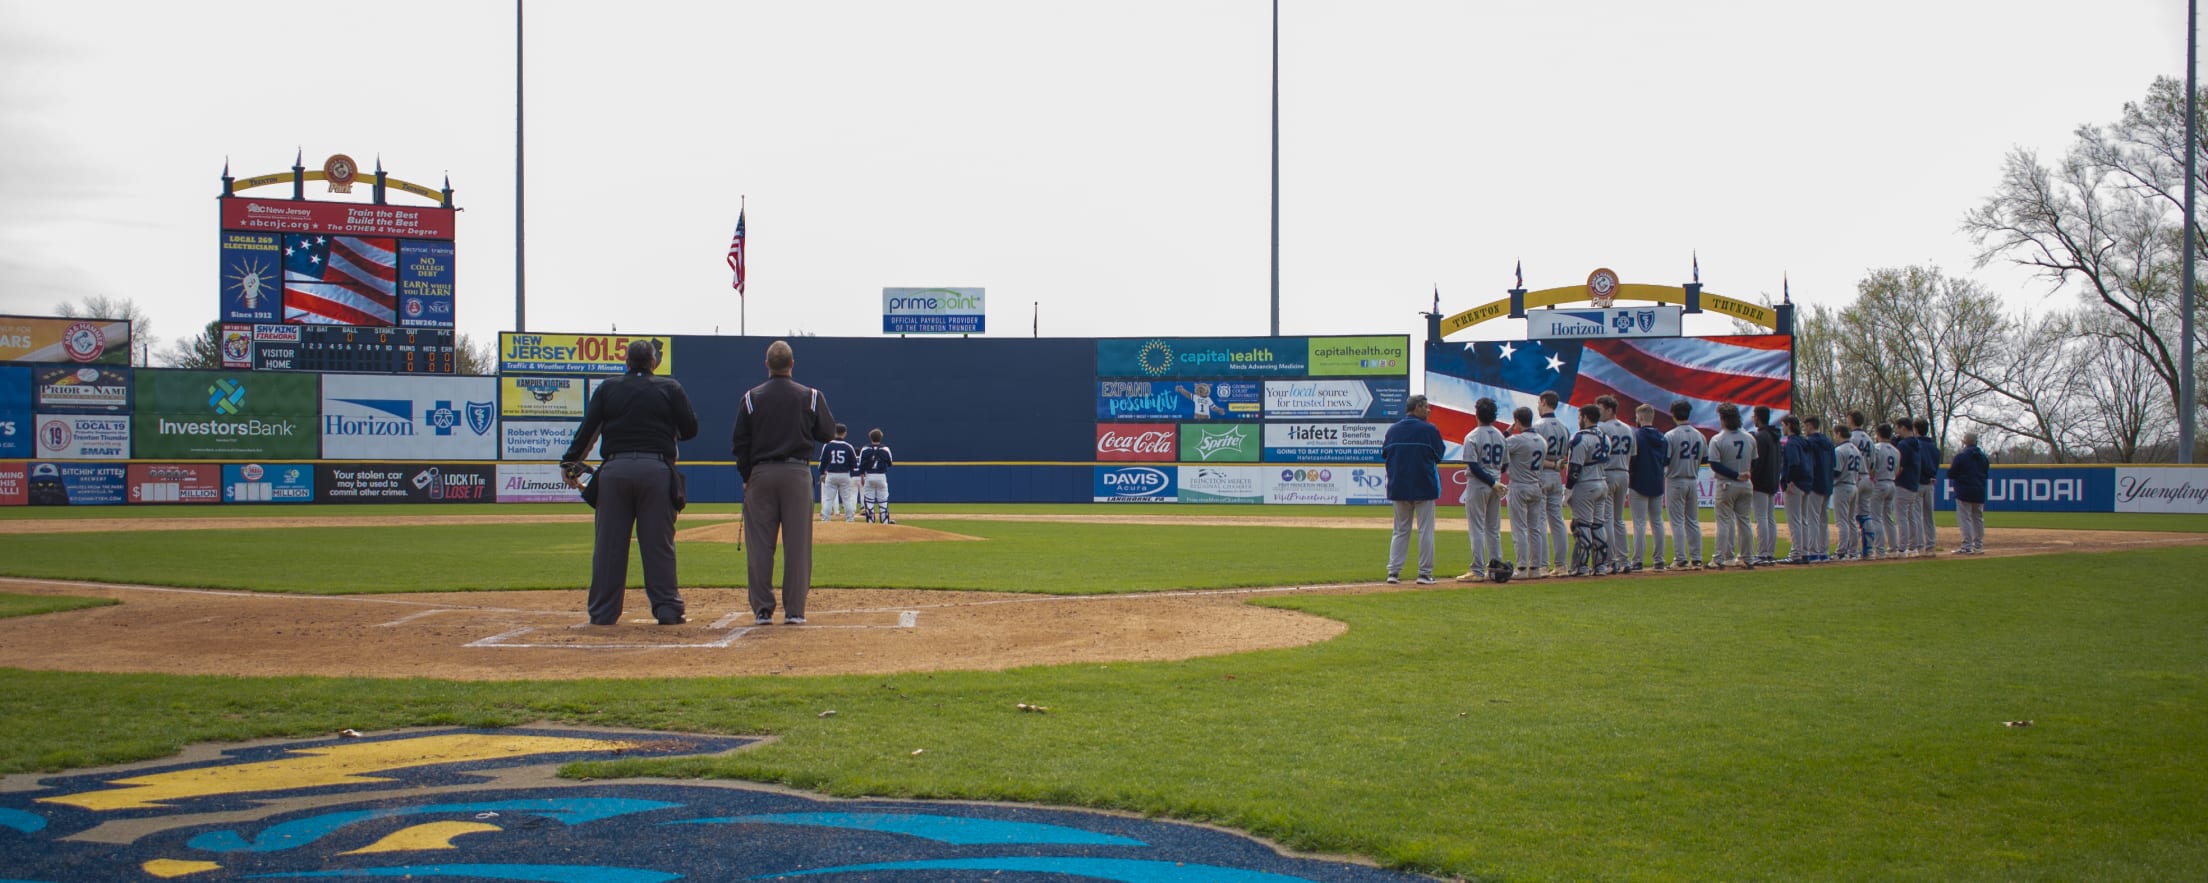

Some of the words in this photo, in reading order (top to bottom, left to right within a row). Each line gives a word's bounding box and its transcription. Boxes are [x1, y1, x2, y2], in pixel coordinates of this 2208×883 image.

[328, 183, 353, 194] Park
[266, 206, 285, 214] New
[285, 207, 311, 216] Jersey
[348, 208, 374, 217] Train
[377, 209, 393, 218] the
[395, 211, 418, 220] Best
[250, 219, 309, 230] abcnjc.org
[347, 217, 374, 225] Build
[377, 218, 393, 226] the
[395, 219, 418, 227] Best
[229, 235, 256, 243] LOCAL
[223, 243, 279, 251] ELECTRICIANS
[420, 257, 436, 265] NO
[410, 264, 445, 272] COLLEGE
[403, 280, 428, 288] EARN
[420, 288, 451, 296] LEARN
[889, 295, 977, 314] primepoint
[1591, 296, 1613, 307] Park
[1712, 298, 1764, 320] THUNDER
[1452, 304, 1500, 328] TRENTON
[256, 325, 275, 333] SKY
[275, 325, 297, 333] KING
[1551, 322, 1605, 336] Horizon
[512, 335, 542, 346] NEW
[262, 349, 295, 358] VISITOR
[507, 345, 577, 361] JERSEY
[575, 336, 630, 361] 101.5
[1314, 345, 1402, 358] capitalhealth.org
[1180, 347, 1274, 365] capitalhealth
[266, 360, 291, 369] HOME
[567, 363, 585, 371] Every
[1248, 363, 1278, 371] Advancing
[40, 384, 80, 395] PRIOR
[93, 385, 126, 395] NAMI
[1101, 381, 1152, 398] EXPAND
[1266, 387, 1288, 398] Your
[1289, 383, 1317, 398] local
[1318, 389, 1349, 397] source
[1109, 388, 1178, 416] possibility
[1277, 398, 1290, 408] for
[1292, 399, 1326, 408] trusted
[1327, 400, 1353, 408] news.
[76, 422, 112, 430] LOCAL
[160, 418, 293, 436] InvestorsBank
[324, 414, 414, 436] Horizon
[1342, 425, 1377, 433] Employee
[49, 427, 63, 445] 19
[507, 428, 537, 436] Robert
[540, 428, 566, 436] Wood
[1288, 425, 1338, 440] Hafetz
[507, 438, 551, 447] University
[1097, 431, 1175, 454] Coca-Cola
[1200, 435, 1241, 451] Sprite
[1548, 435, 1565, 456] 21
[1610, 435, 1632, 455] 23
[1858, 440, 1870, 457] 44
[80, 448, 121, 456] SMART
[507, 446, 547, 454] Hamilton
[1679, 441, 1700, 460] 24
[1734, 440, 1745, 459] 7
[831, 450, 846, 464] 15
[1531, 450, 1543, 470] 2
[1848, 455, 1861, 472] 26
[1887, 456, 1895, 472] 9
[333, 469, 355, 479] Your
[357, 470, 384, 479] stolen
[445, 474, 468, 485] LOCK
[470, 474, 479, 485] IT
[1103, 473, 1159, 485] DAVIS
[337, 481, 355, 489] may
[356, 480, 368, 488] be
[369, 480, 388, 488] used
[390, 480, 399, 488] to
[1943, 478, 2083, 501] HUNDAI
[2116, 475, 2208, 504] Yuengling
[273, 489, 308, 497] MILLION
[329, 488, 358, 496] commit
[360, 488, 380, 496] other
[381, 488, 409, 496] crimes.
[445, 486, 471, 499] LOSE
[473, 485, 485, 499] IT
